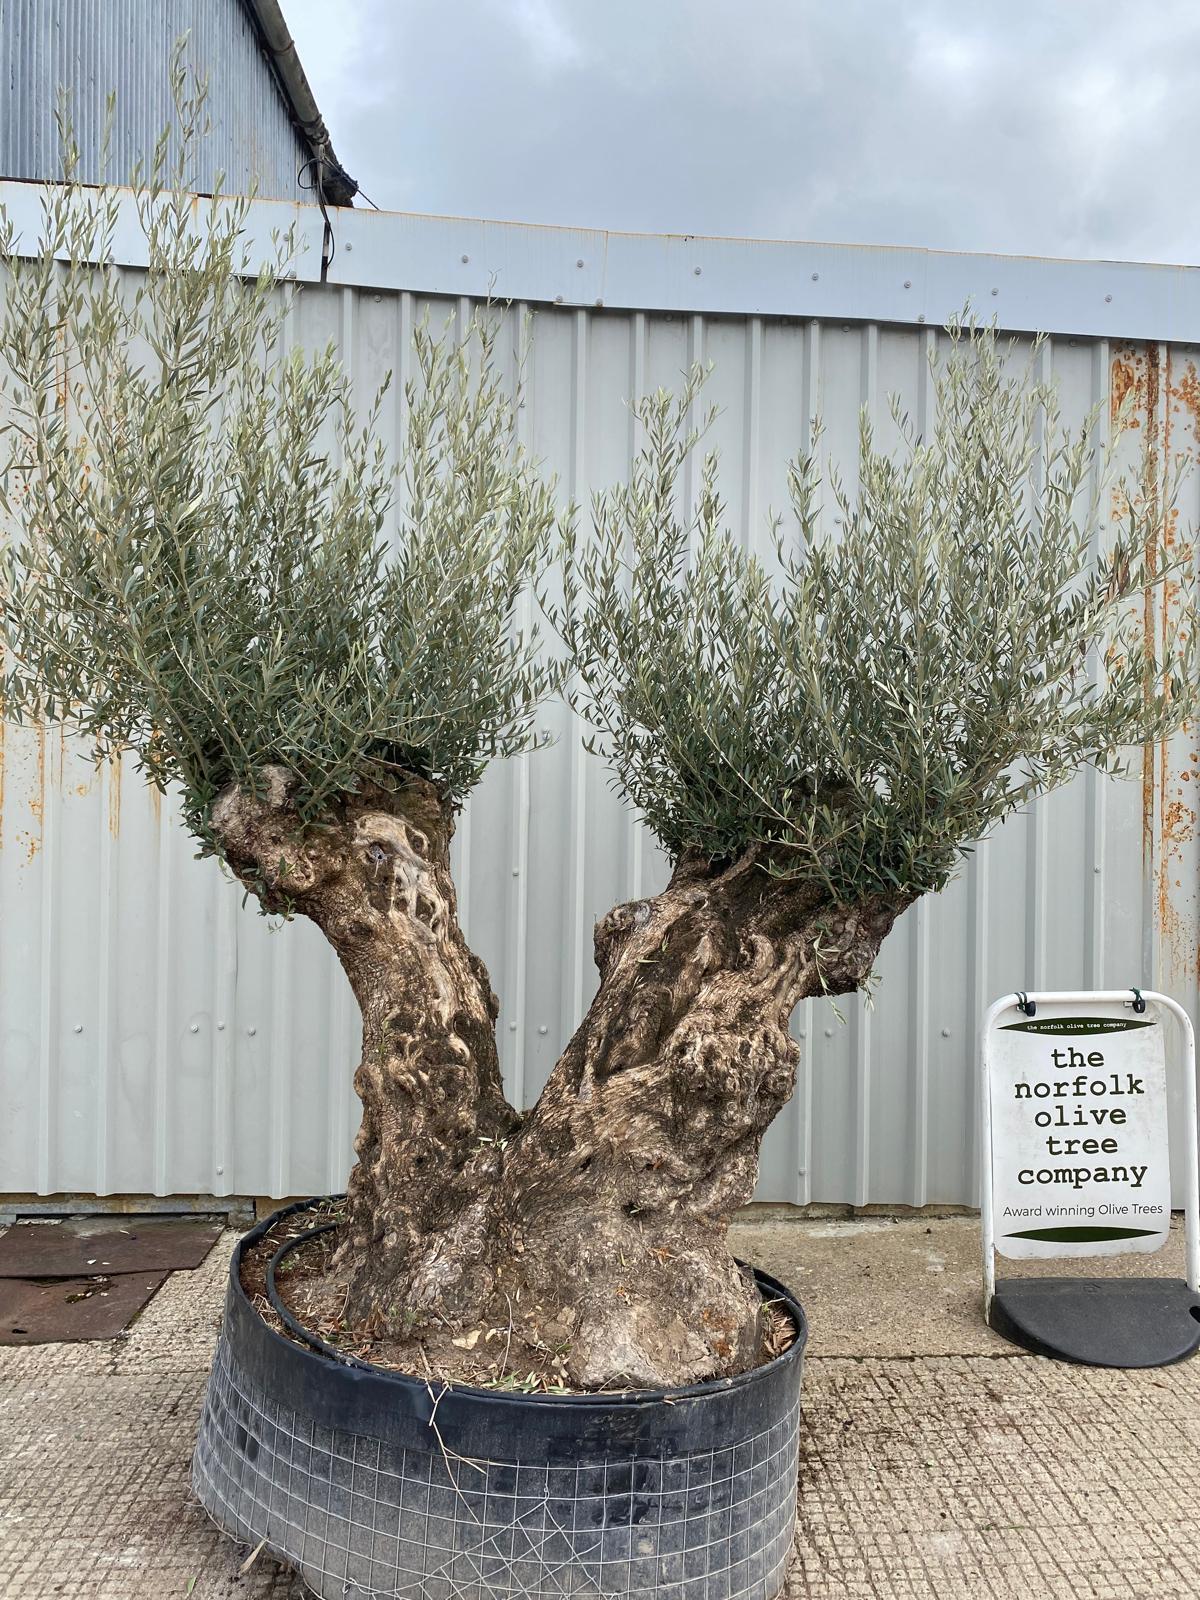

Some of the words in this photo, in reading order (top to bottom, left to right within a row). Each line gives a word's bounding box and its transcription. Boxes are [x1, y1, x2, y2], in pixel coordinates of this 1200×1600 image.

[1051, 1047, 1105, 1069] the
[1014, 1073, 1145, 1099] norfolk
[1034, 1104, 1127, 1127] olive
[1046, 1135, 1118, 1156] tree
[1017, 1165, 1148, 1189] company
[1003, 1205, 1042, 1217] Award
[1045, 1204, 1095, 1218] winning
[1098, 1204, 1129, 1215] Olive
[1131, 1203, 1163, 1215] Trees
